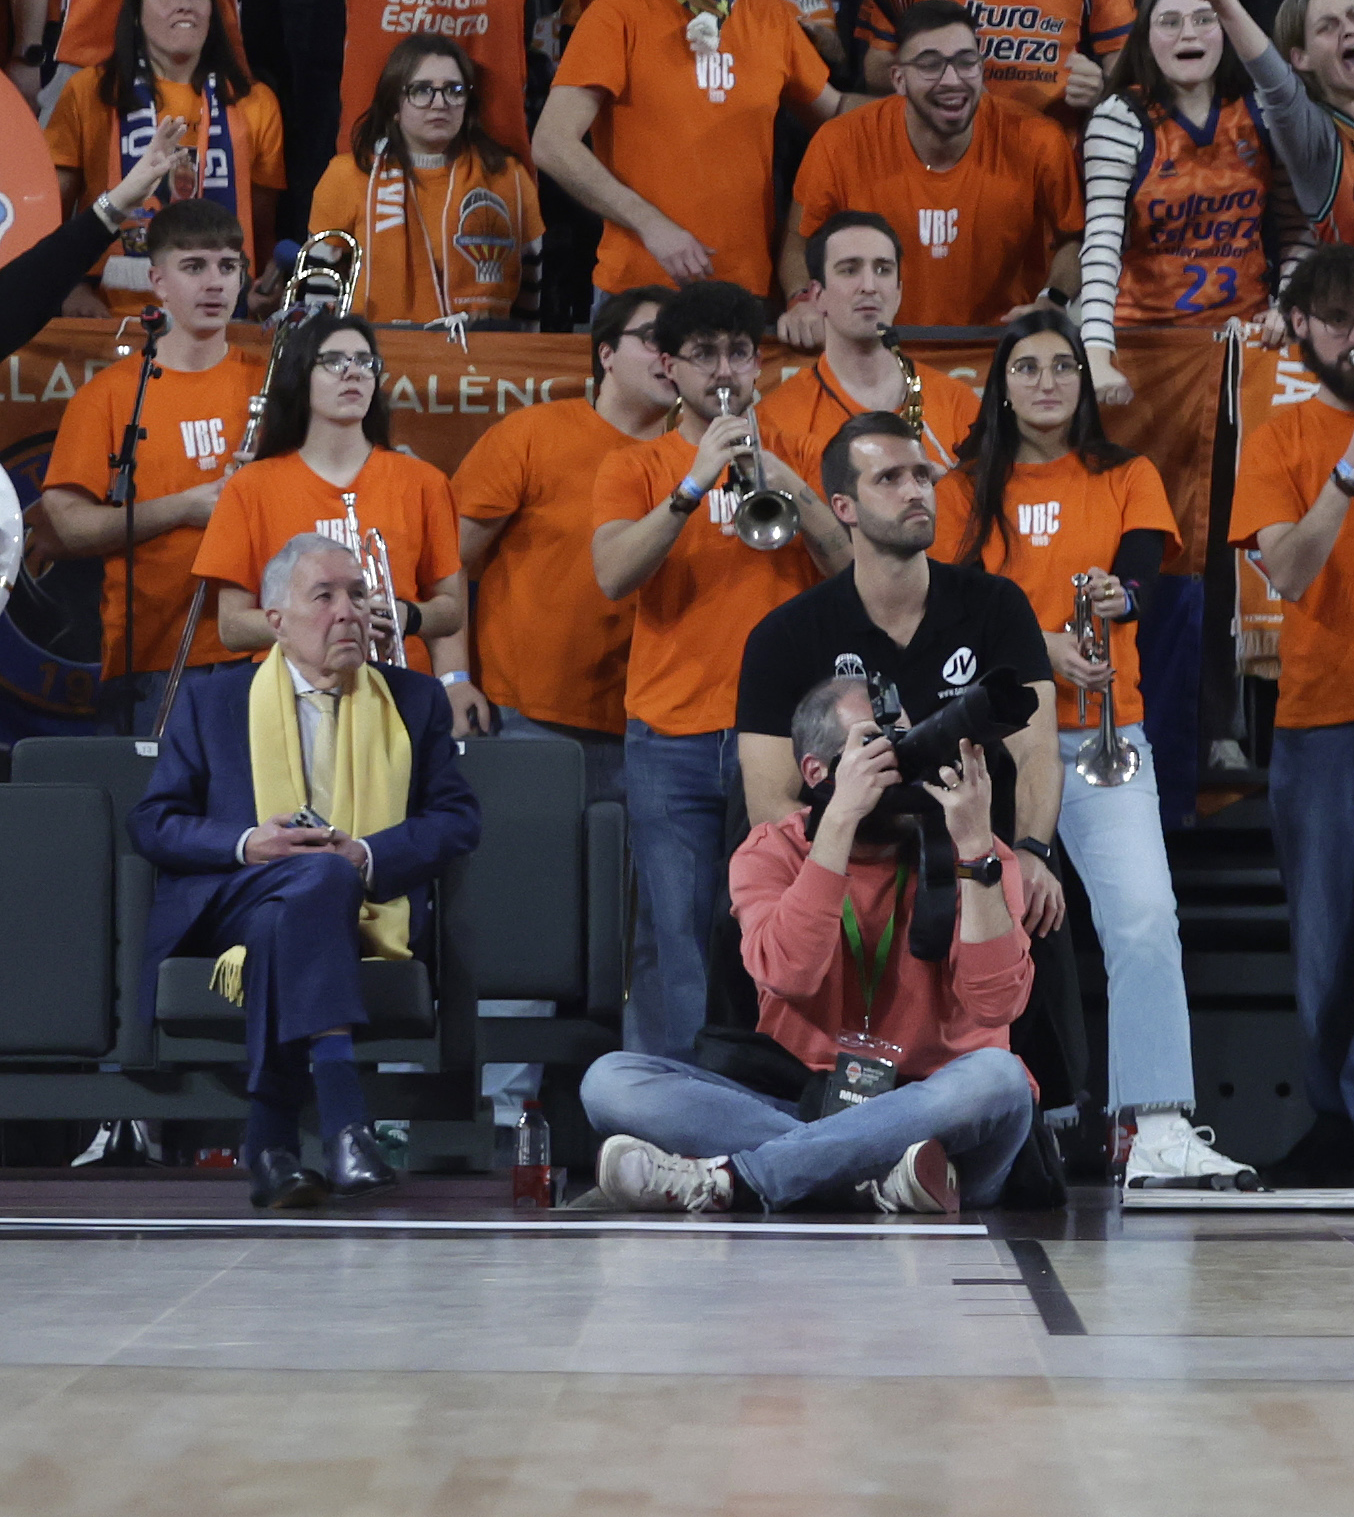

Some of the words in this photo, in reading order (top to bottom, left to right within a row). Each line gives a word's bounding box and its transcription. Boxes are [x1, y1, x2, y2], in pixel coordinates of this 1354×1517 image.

[381, 4, 489, 36] Esfuerzo
[1148, 189, 1257, 222] Cultura
[1151, 217, 1261, 244] Esfuerz
[1175, 265, 1238, 312] 23
